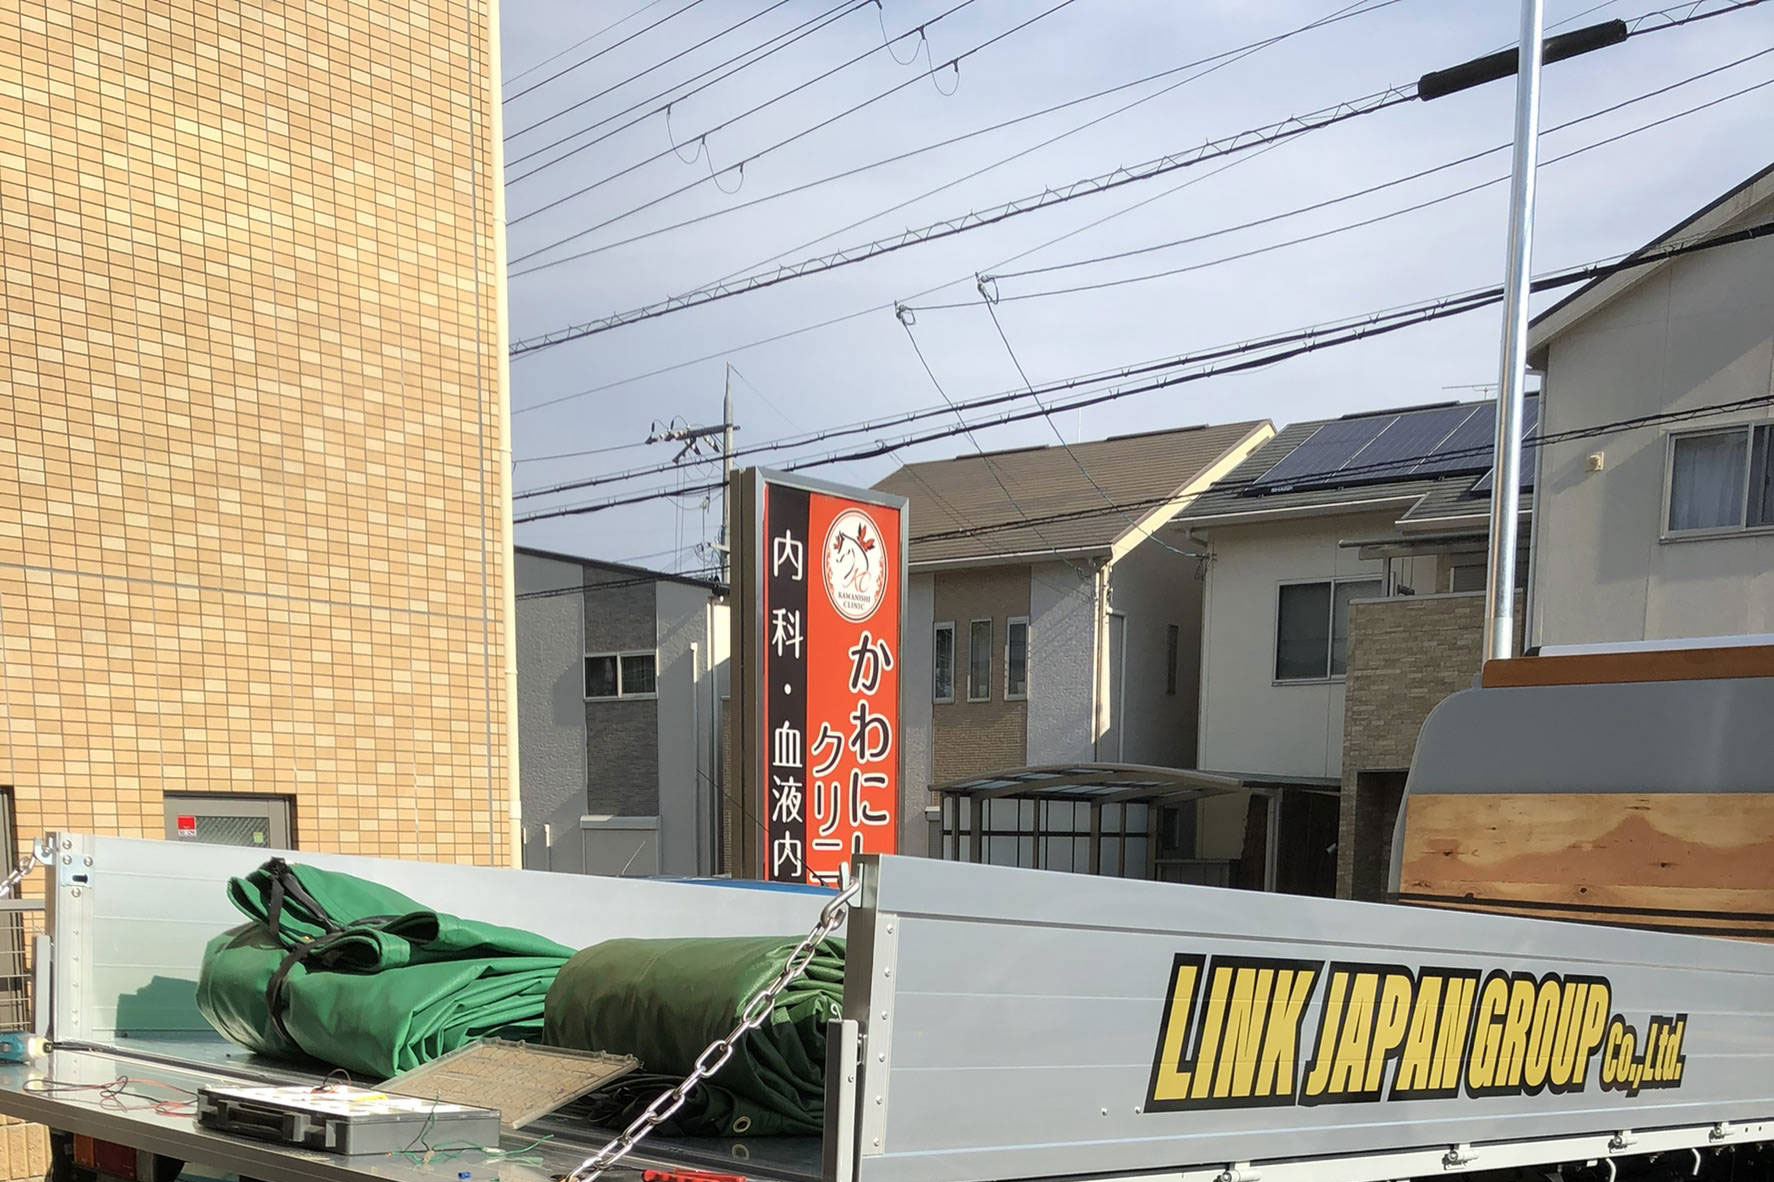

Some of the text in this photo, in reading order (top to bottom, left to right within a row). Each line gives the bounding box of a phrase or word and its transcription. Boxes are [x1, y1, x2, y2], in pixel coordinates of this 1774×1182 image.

[1149, 959, 1319, 1106] LINK
[1302, 966, 1479, 1101] JAPAN
[1465, 972, 1612, 1094] GROUP
